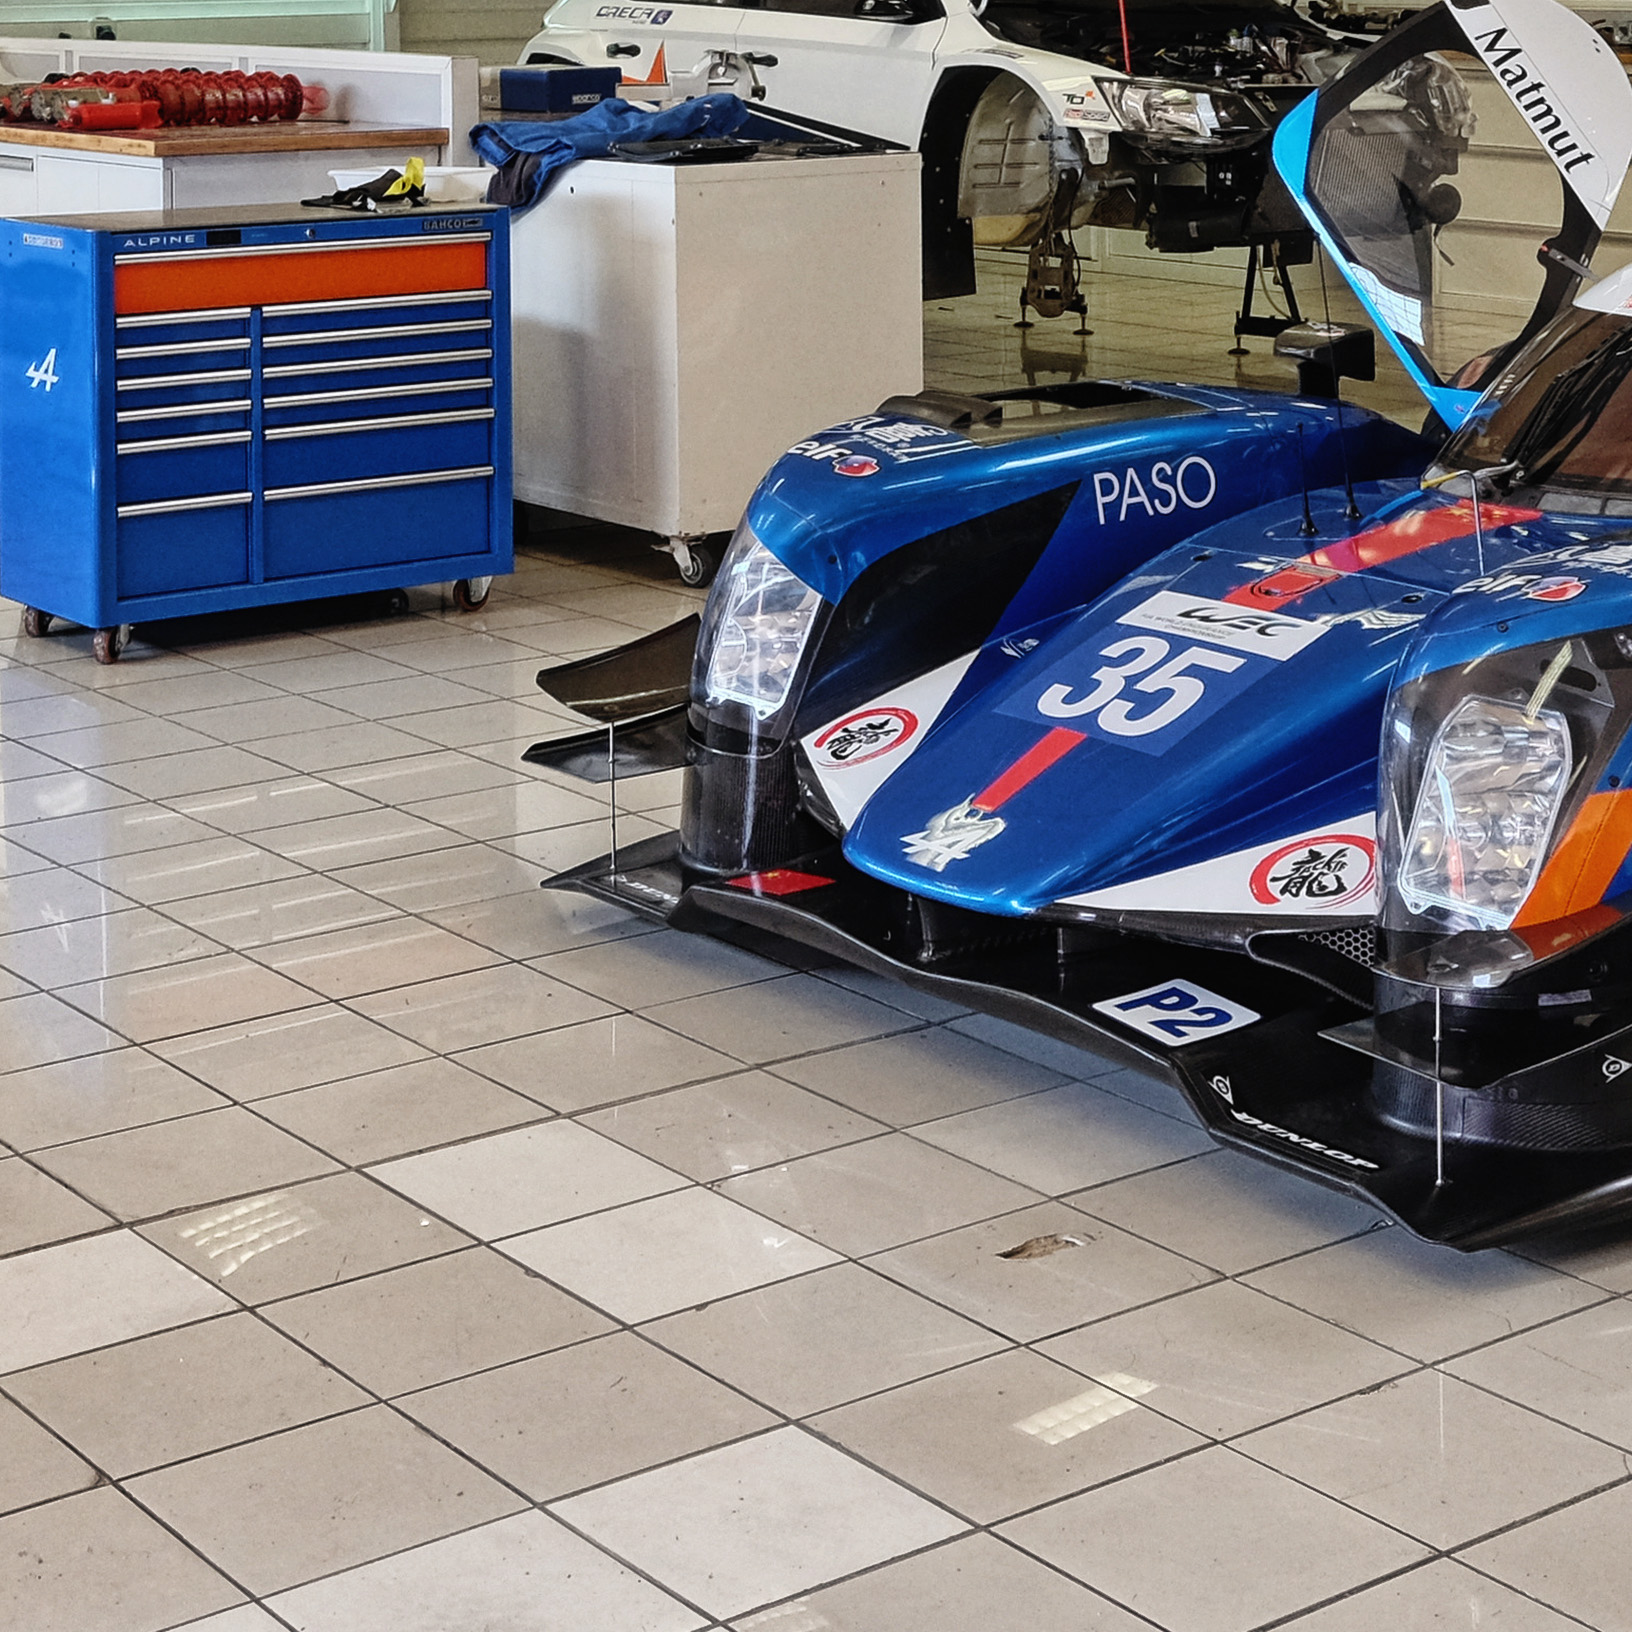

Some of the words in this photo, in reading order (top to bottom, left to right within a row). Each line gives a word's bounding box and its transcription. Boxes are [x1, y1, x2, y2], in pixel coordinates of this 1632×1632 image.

[596, 5, 655, 19] ORECA
[1474, 26, 1595, 175] Matmut
[124, 234, 195, 248] ALPINE
[787, 440, 853, 461] elf
[1094, 456, 1216, 525] PASO
[1453, 573, 1544, 595] elf
[1037, 635, 1248, 737] 35
[1115, 988, 1220, 1038] P2
[1230, 1109, 1379, 1169] DUNLOP
